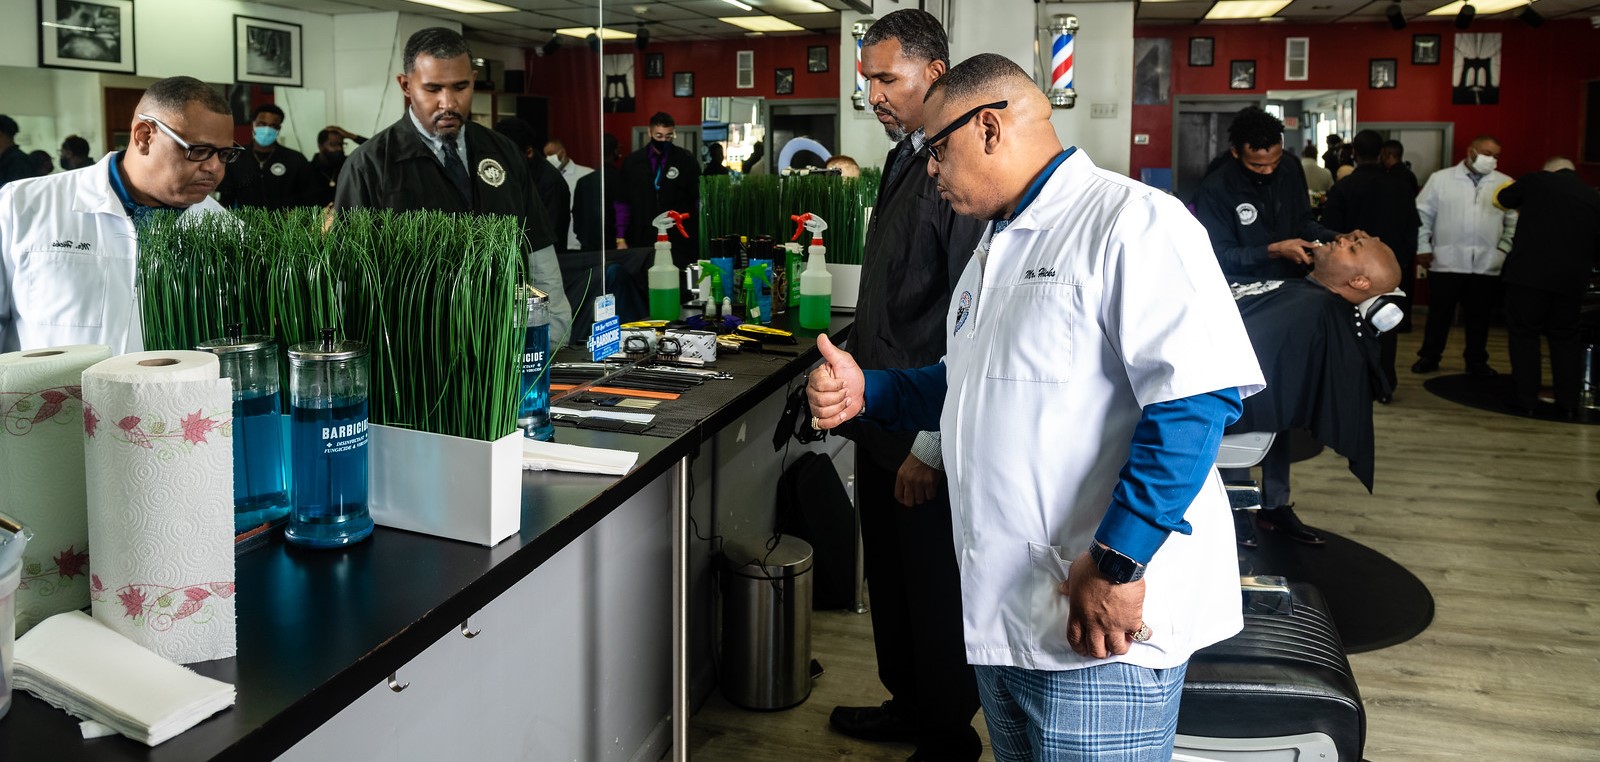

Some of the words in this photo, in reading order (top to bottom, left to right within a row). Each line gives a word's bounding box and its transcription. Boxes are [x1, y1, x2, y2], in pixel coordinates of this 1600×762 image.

[1037, 267, 1055, 278] Hicks
[596, 328, 620, 348] BARBICIDE
[324, 445, 352, 453] FUNGICIDE
